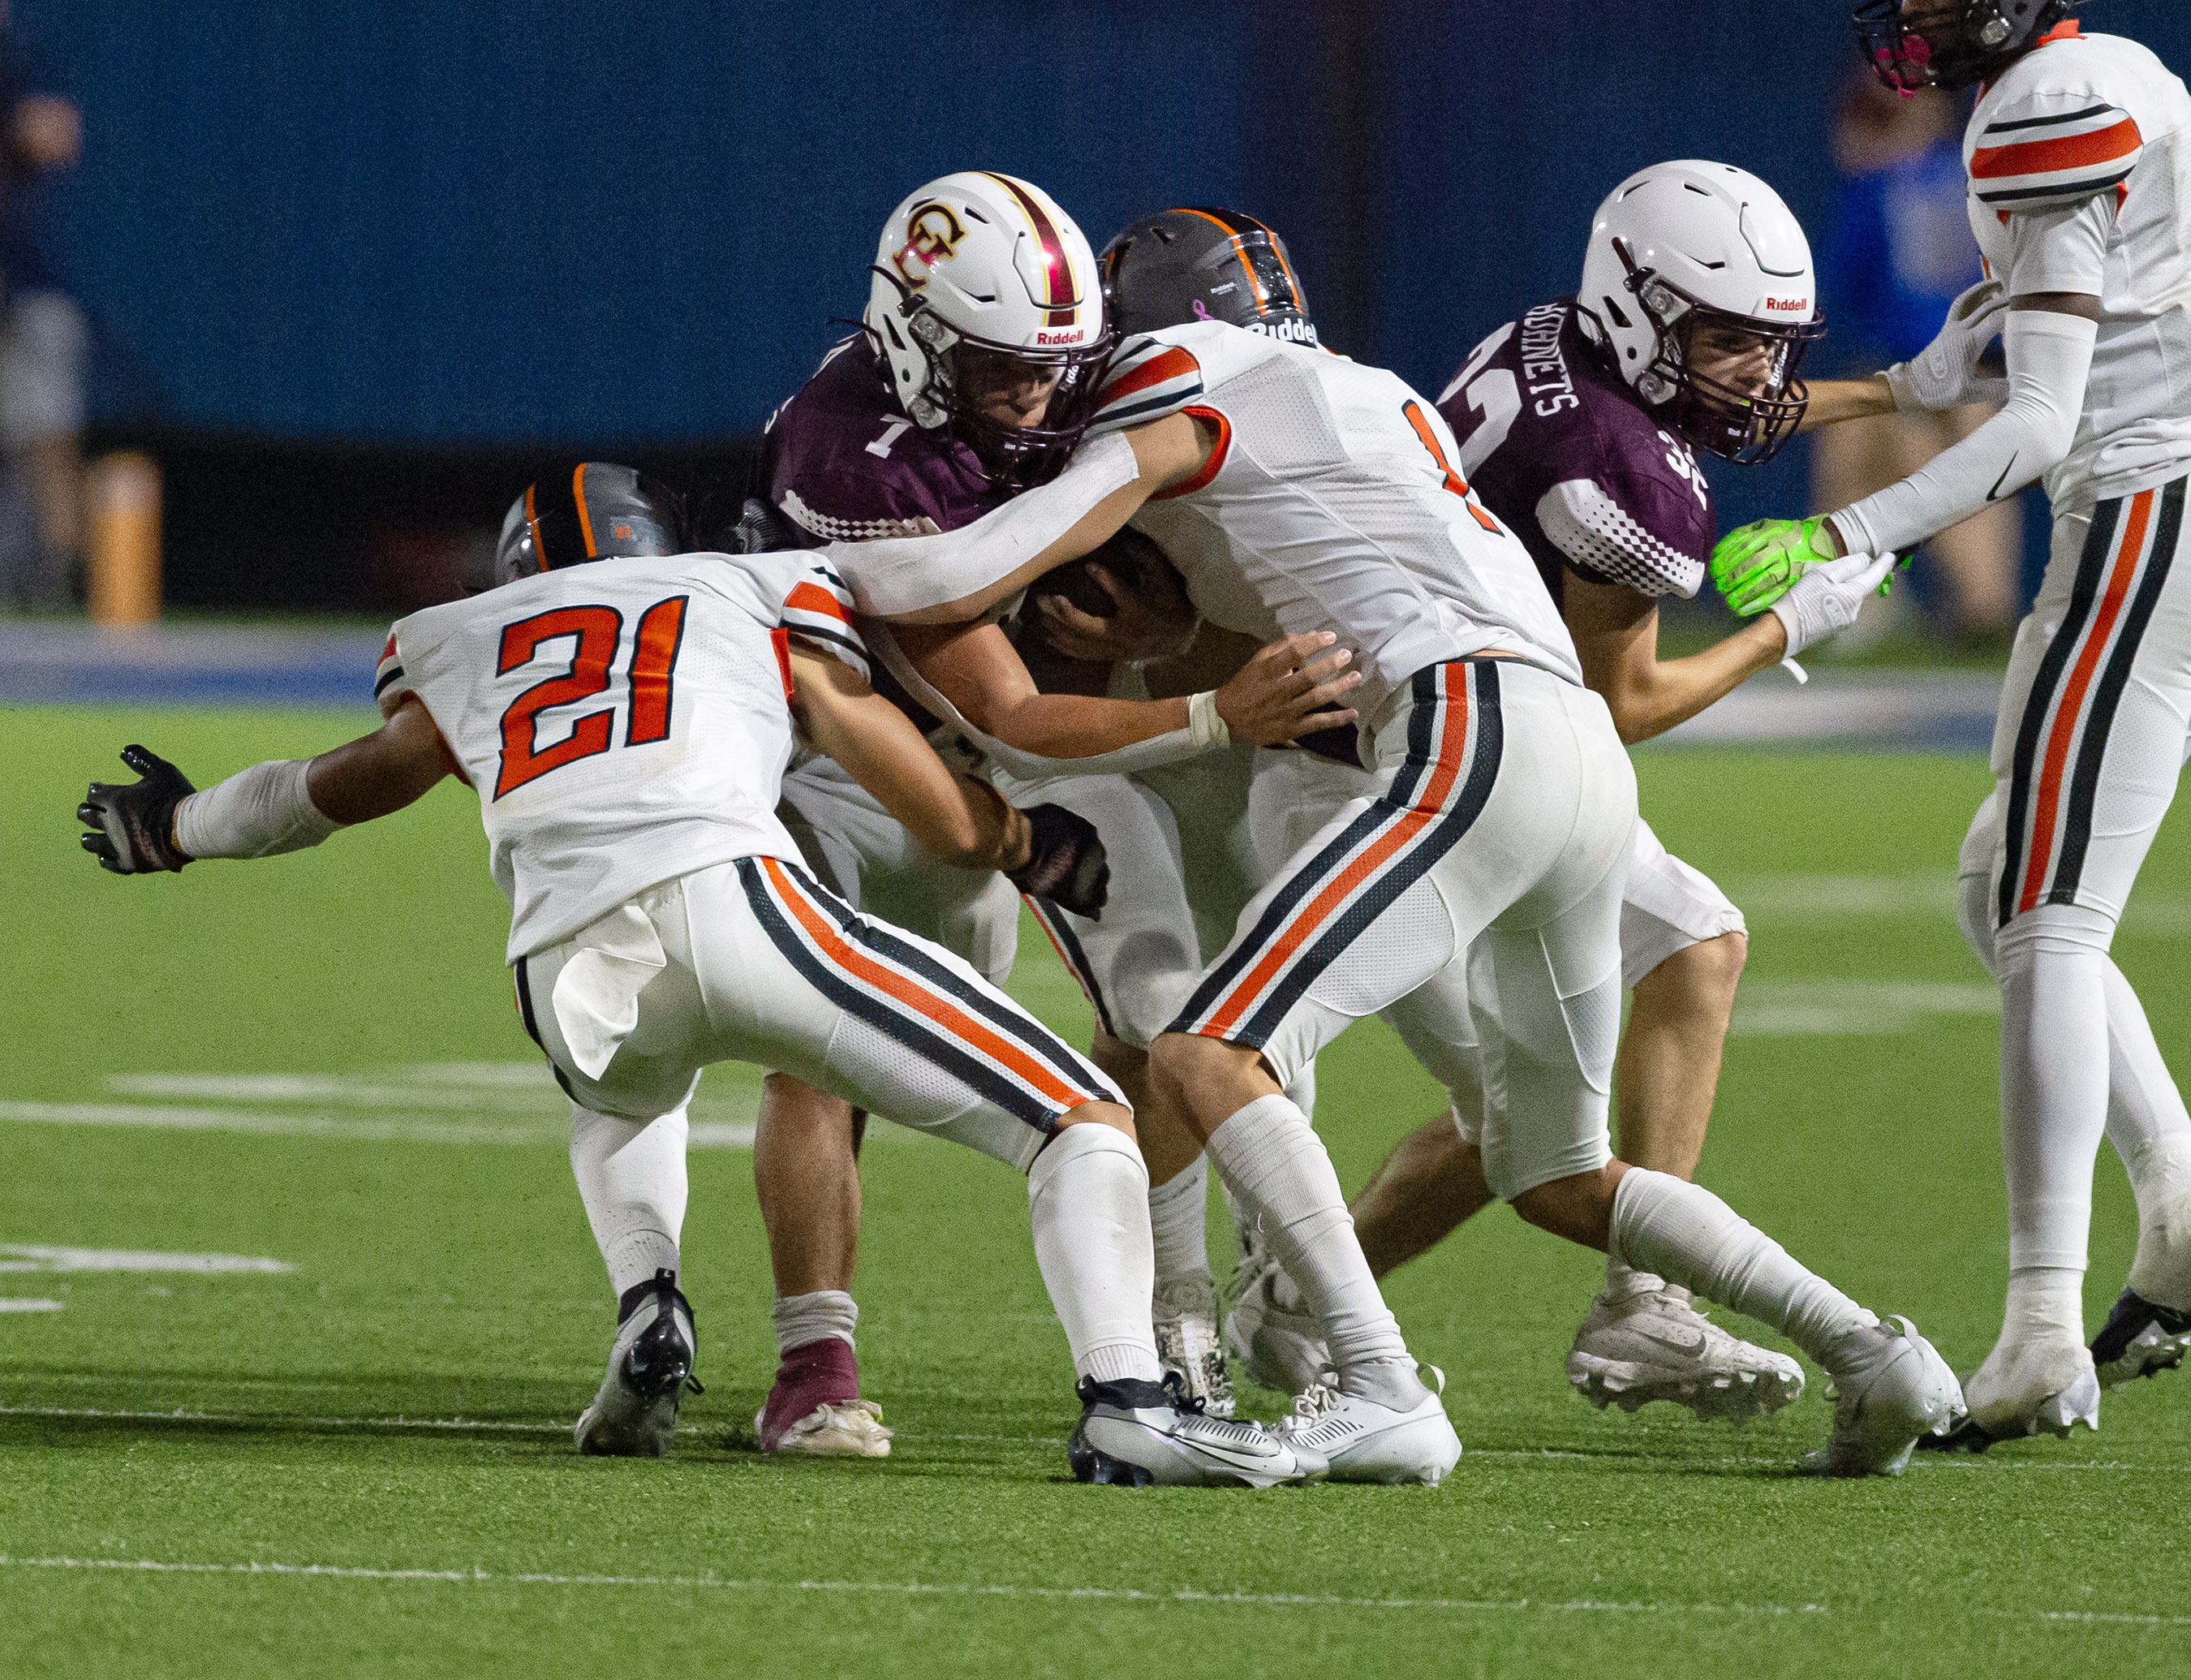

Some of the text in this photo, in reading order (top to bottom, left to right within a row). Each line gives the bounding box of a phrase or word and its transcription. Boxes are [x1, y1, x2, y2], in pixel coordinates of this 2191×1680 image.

[1766, 297, 1807, 311] Riddell
[1037, 330, 1084, 344] Riddell
[1521, 302, 1580, 416] HORNETS
[492, 595, 690, 803] 21
